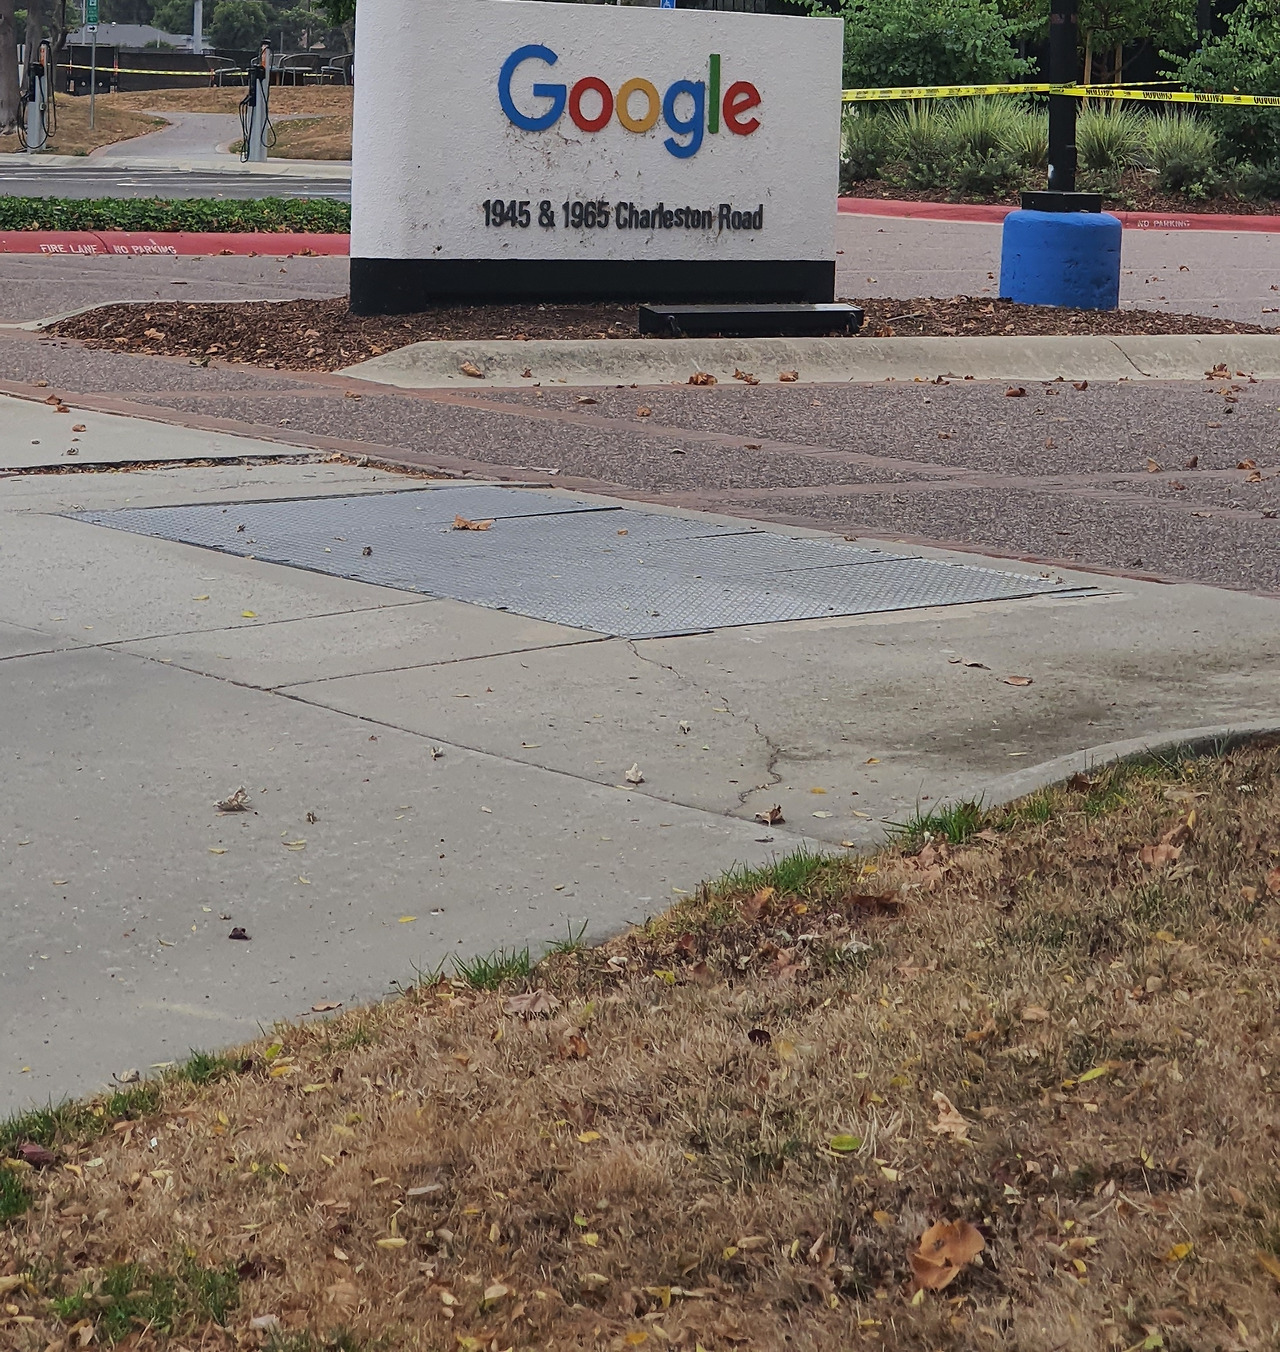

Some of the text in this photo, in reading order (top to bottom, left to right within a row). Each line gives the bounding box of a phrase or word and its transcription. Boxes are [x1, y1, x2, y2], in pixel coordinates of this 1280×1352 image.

[497, 44, 761, 158] Google
[482, 199, 764, 231] 1945 & 1965 Charleston Road
[1137, 219, 1190, 228] NO PARKING
[40, 244, 67, 253] FIRE
[113, 244, 129, 254] NO
[131, 244, 177, 255] PARKING
